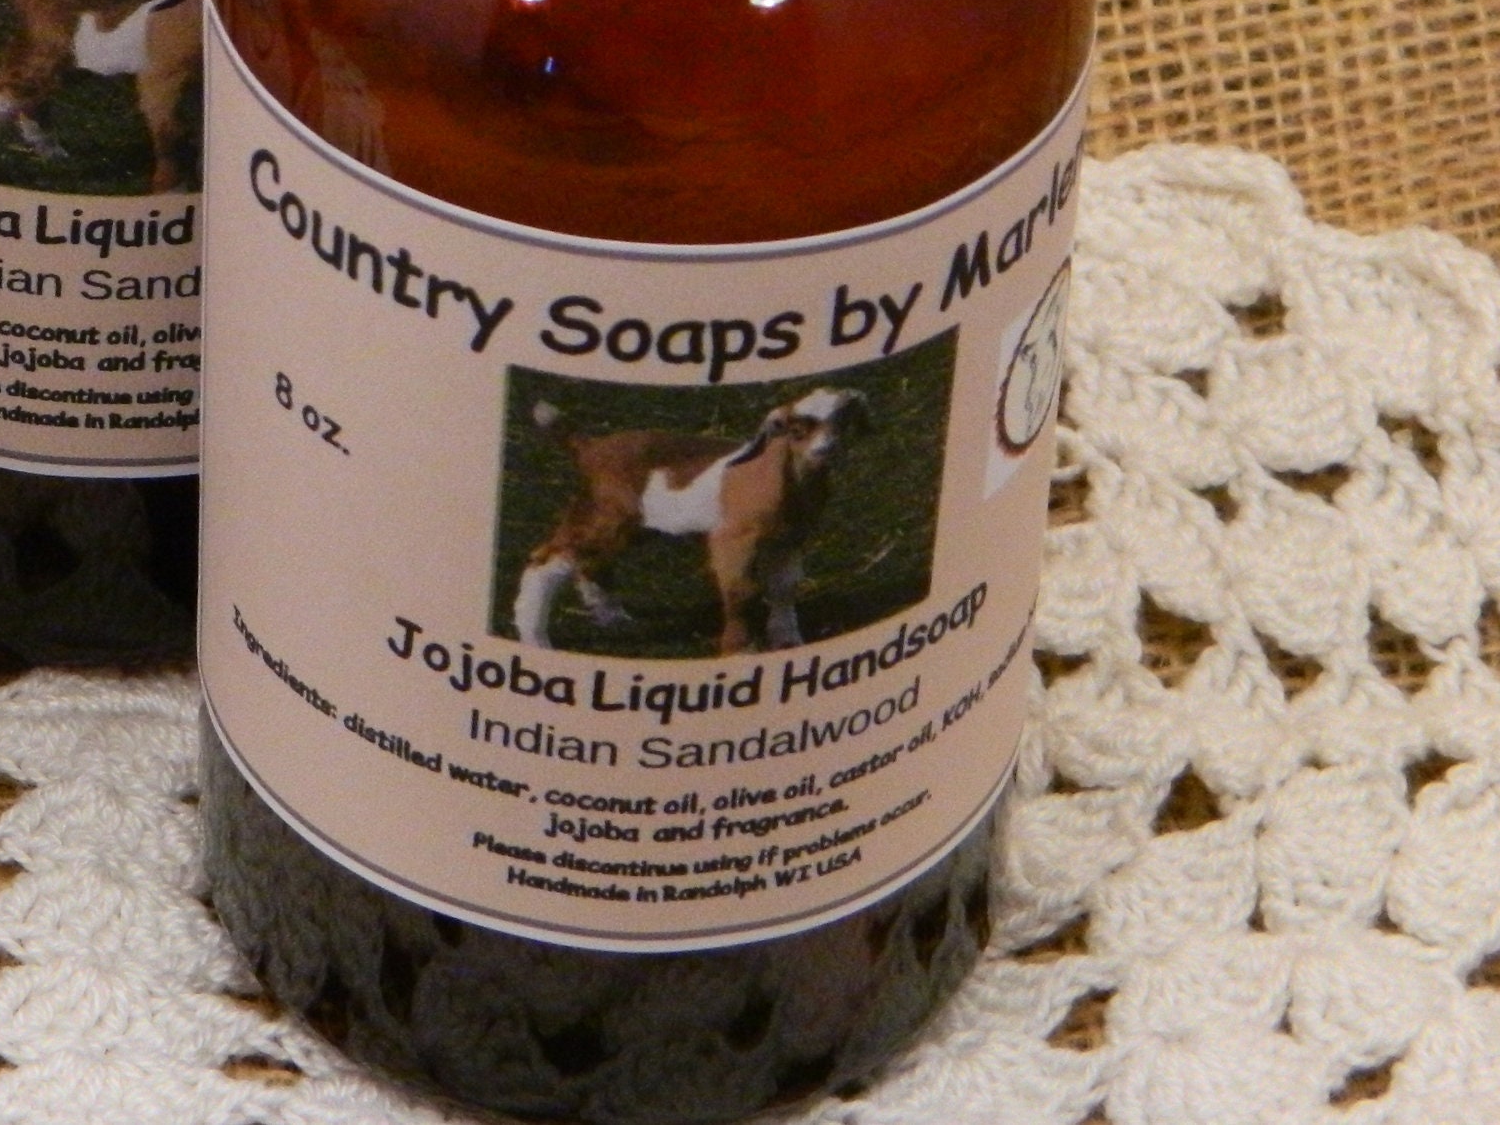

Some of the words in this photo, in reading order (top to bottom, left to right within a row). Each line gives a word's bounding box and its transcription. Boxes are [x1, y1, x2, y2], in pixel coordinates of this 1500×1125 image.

[35, 204, 196, 259] Liquid
[249, 148, 513, 352] Country
[540, 294, 804, 383] Soaps
[831, 282, 923, 353] by
[940, 130, 1083, 312] Marle
[81, 265, 200, 301] Sand
[97, 351, 145, 373] and
[106, 324, 146, 348] oil,
[152, 321, 200, 344] oliv
[5, 379, 133, 406] discontinue
[136, 386, 194, 409] using
[84, 409, 104, 430] in
[274, 371, 294, 410] 8
[302, 402, 352, 457] oz.
[387, 615, 577, 708] Jojoba
[591, 663, 763, 725] Liquid
[779, 581, 988, 709] Handsoap
[469, 707, 619, 768] Indian
[638, 674, 922, 770] Sandalwood
[342, 712, 443, 773] distilled
[448, 762, 539, 805] water,
[543, 788, 658, 816] coconut
[663, 791, 707, 816] oil,
[711, 786, 778, 812] olive
[782, 773, 823, 801] oil,
[828, 743, 905, 790] castor
[906, 720, 938, 754] oil,
[472, 830, 548, 865] Please
[551, 850, 689, 877] discontinue
[692, 854, 754, 875] using
[757, 845, 781, 867] if
[781, 818, 878, 866] problems
[879, 788, 933, 826] occur.
[543, 811, 641, 844] jojoba
[652, 819, 706, 844] and
[711, 798, 850, 841] fragrance.
[506, 865, 631, 902] Handmade
[635, 885, 659, 903] in
[661, 873, 768, 903] Randolph
[773, 863, 814, 888] WI
[815, 845, 863, 877] USA
